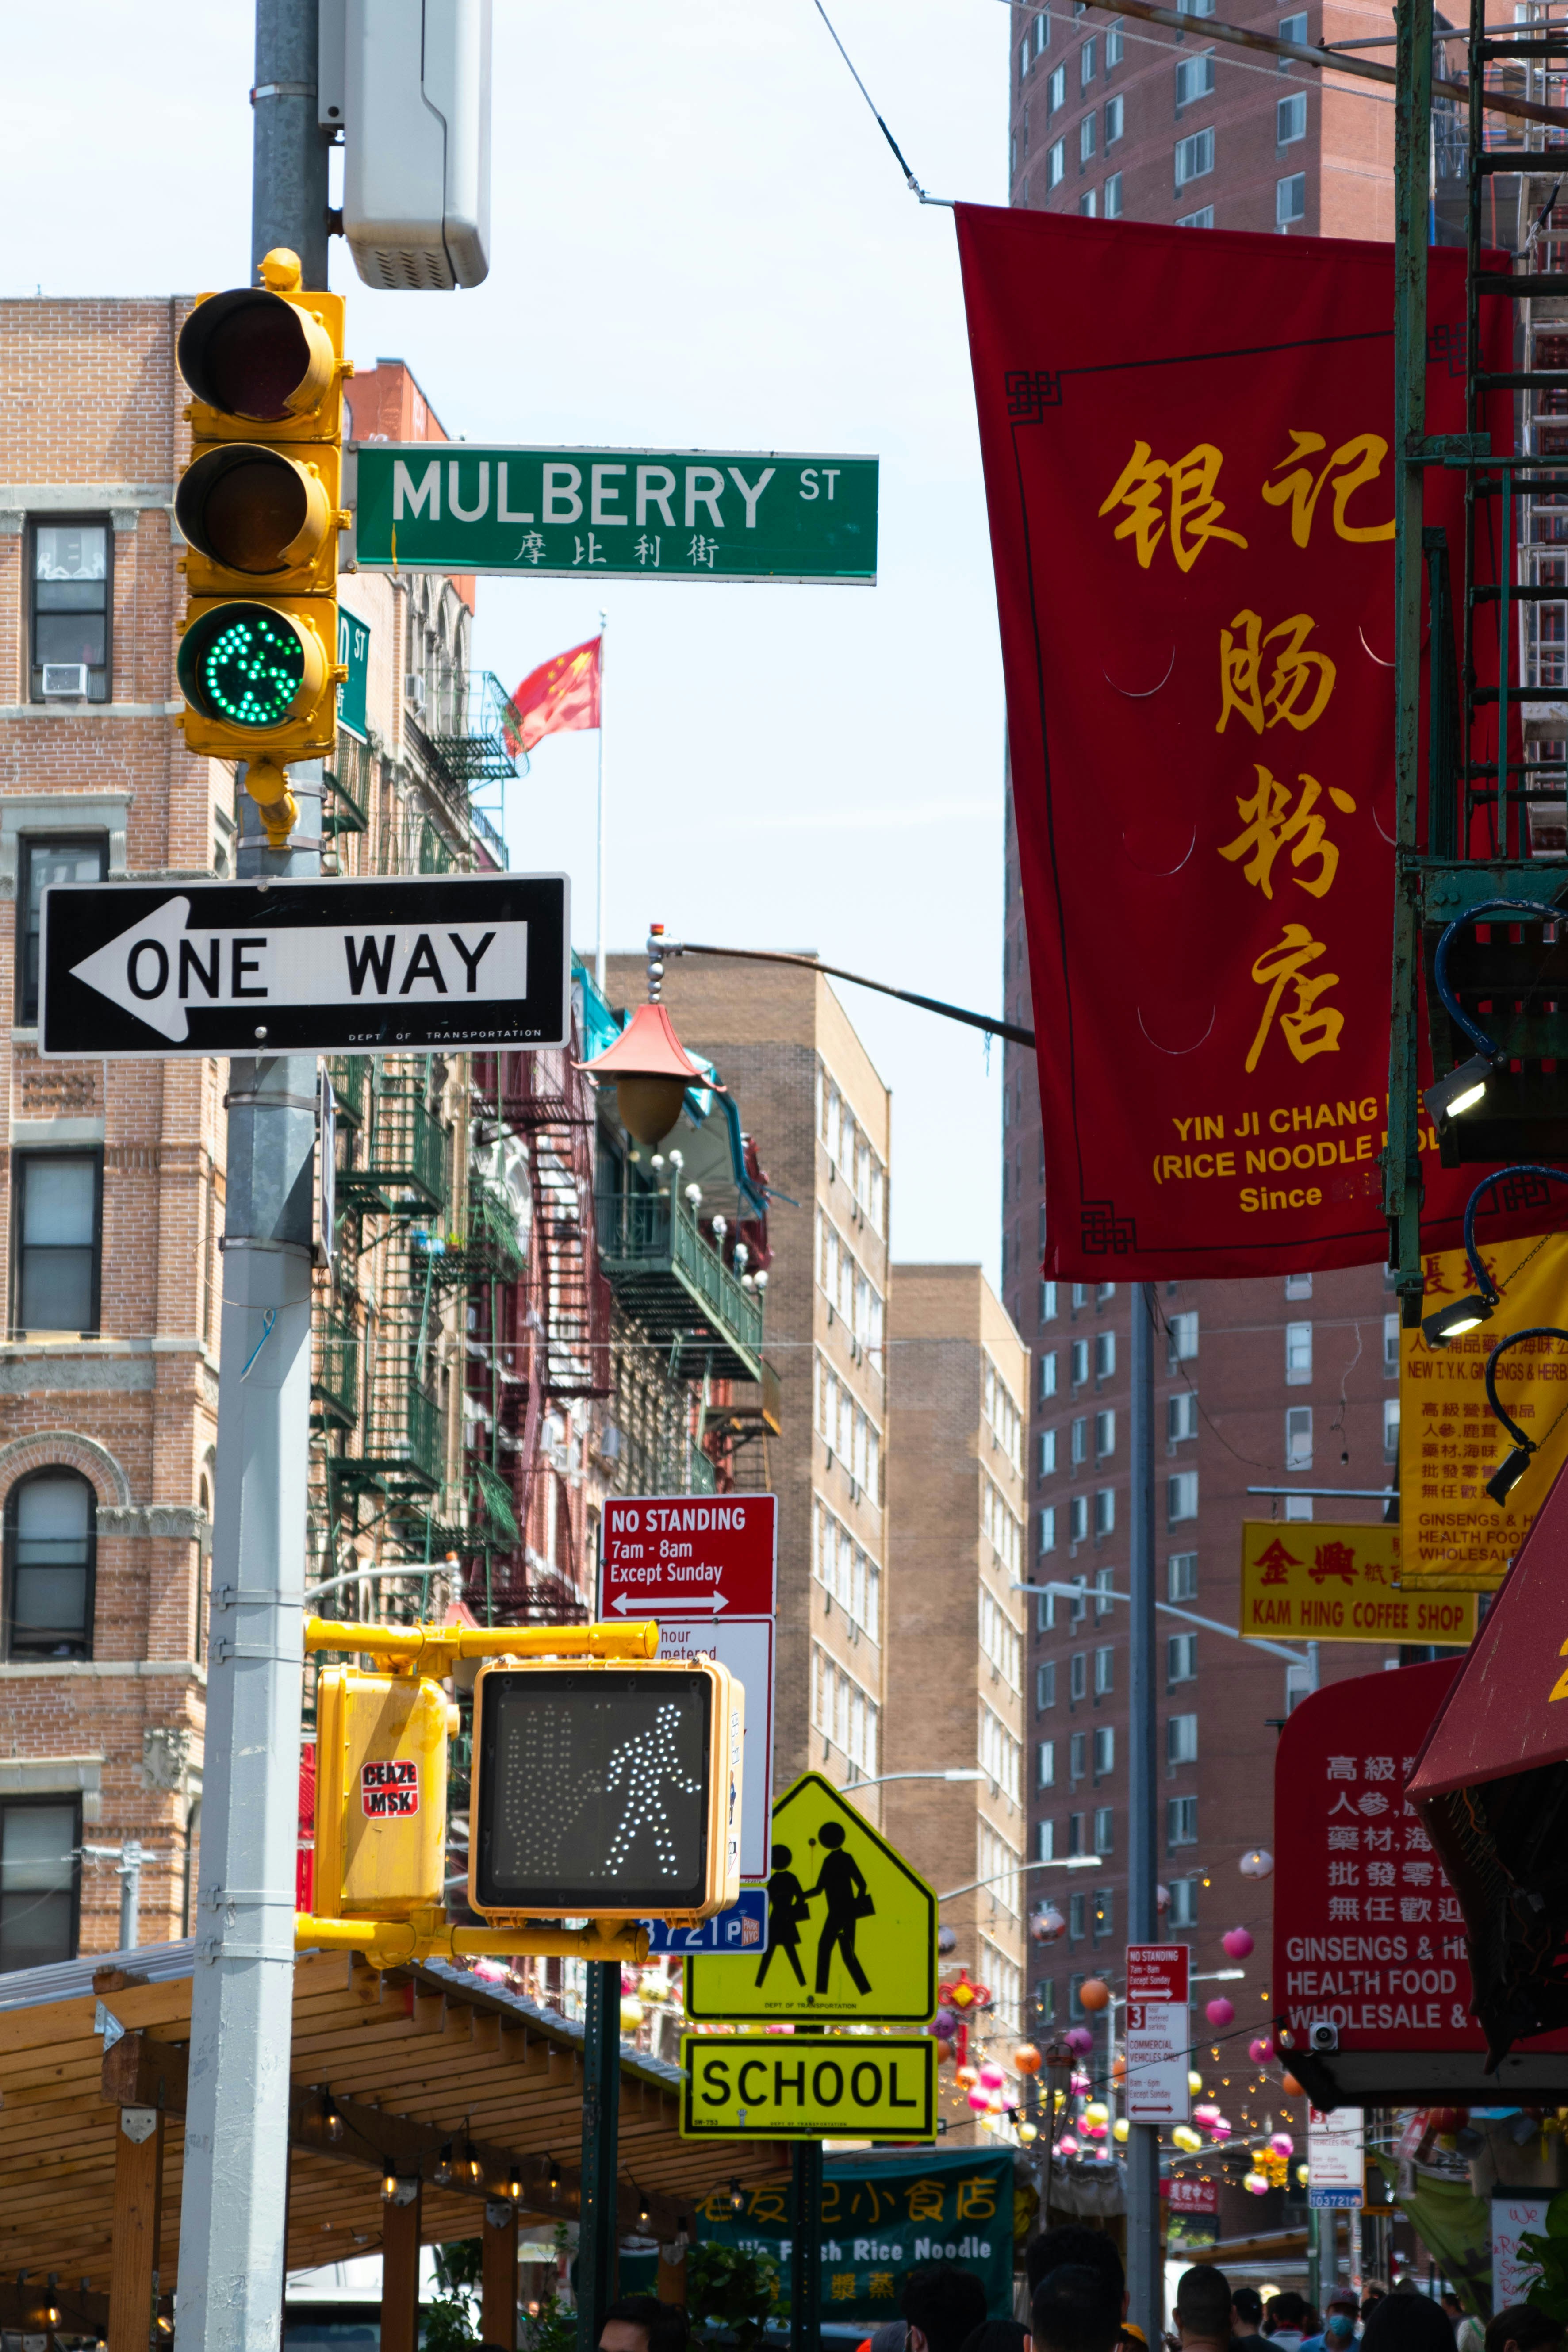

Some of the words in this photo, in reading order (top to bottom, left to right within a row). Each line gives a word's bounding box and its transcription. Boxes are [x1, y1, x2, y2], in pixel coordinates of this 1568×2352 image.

[393, 460, 776, 528] MULBERRY
[799, 468, 840, 501] ST
[514, 530, 720, 568] 摩比利街
[354, 628, 365, 662] ST
[127, 937, 268, 1000] ONE
[344, 932, 497, 996] WAY
[426, 1029, 541, 1040] TRANSPORTATION
[1172, 1115, 1224, 1142] YIN
[1234, 1112, 1259, 1137] JI
[1269, 1097, 1378, 1134] CHANG
[1153, 1151, 1236, 1185] (RICE
[1246, 1135, 1373, 1174] NOODLE
[1239, 1186, 1322, 1213] Since
[1408, 1361, 1433, 1379] NEW
[1471, 1362, 1523, 1381] GINENGS
[1526, 1364, 1535, 1381] &
[612, 1509, 639, 1532] NO
[646, 1507, 745, 1532] STANDING
[1419, 1513, 1500, 1526] GINSENGS
[1506, 1514, 1516, 1526] &
[1419, 1531, 1481, 1543] HEALTH
[611, 1540, 644, 1559] 7am
[659, 1539, 692, 1558] 8am
[1253, 1537, 1359, 1586] 金興
[611, 1563, 662, 1585] Except
[667, 1562, 723, 1585] Sunday
[1253, 1599, 1291, 1626] KAM
[1301, 1600, 1344, 1627] HING
[1353, 1601, 1409, 1630] COFFEE
[1418, 1604, 1464, 1631] SHOP
[661, 1628, 691, 1643] hour
[364, 1764, 417, 1786] CEAZE
[1326, 1756, 1416, 1781] 高級
[371, 1792, 411, 1813] MSK
[1328, 1791, 1418, 1818] 人參,
[1328, 1896, 1465, 1923] 無任歡迎
[743, 1919, 758, 1930] PARK
[743, 1930, 759, 1944] NYC
[1130, 1951, 1140, 1961] NO
[1142, 1950, 1179, 1962] STANDING
[1286, 1936, 1407, 1961] GINSENGS
[1418, 1936, 1434, 1961] &
[1130, 1965, 1142, 1974] 7am
[1147, 1965, 1160, 1974] 8am
[1130, 1976, 1149, 1985] Except
[1150, 1976, 1171, 1986] Sunday
[1287, 1970, 1380, 1996] HEALTH
[1389, 1970, 1457, 1995] FOOD
[1131, 2007, 1142, 2029] 3
[1148, 2023, 1166, 2032] parking
[1288, 2004, 1441, 2030] WHOLESALE
[1451, 2003, 1468, 2028] &
[1130, 2040, 1173, 2050] COMMERCIAL
[1130, 2053, 1161, 2063] VEHICLES
[1163, 2052, 1180, 2062] ONLY
[701, 2060, 917, 2108] SCHOOL
[1129, 2079, 1142, 2087] 8am
[1147, 2078, 1160, 2089] 6pm
[1129, 2090, 1149, 2099] Except
[1150, 2089, 1171, 2100] Sunday
[1311, 2196, 1349, 2206] 103721
[1509, 2204, 1539, 2225] We
[780, 2239, 842, 2262] Fsh
[854, 2238, 904, 2261] Rice
[914, 2237, 992, 2260] Noodle
